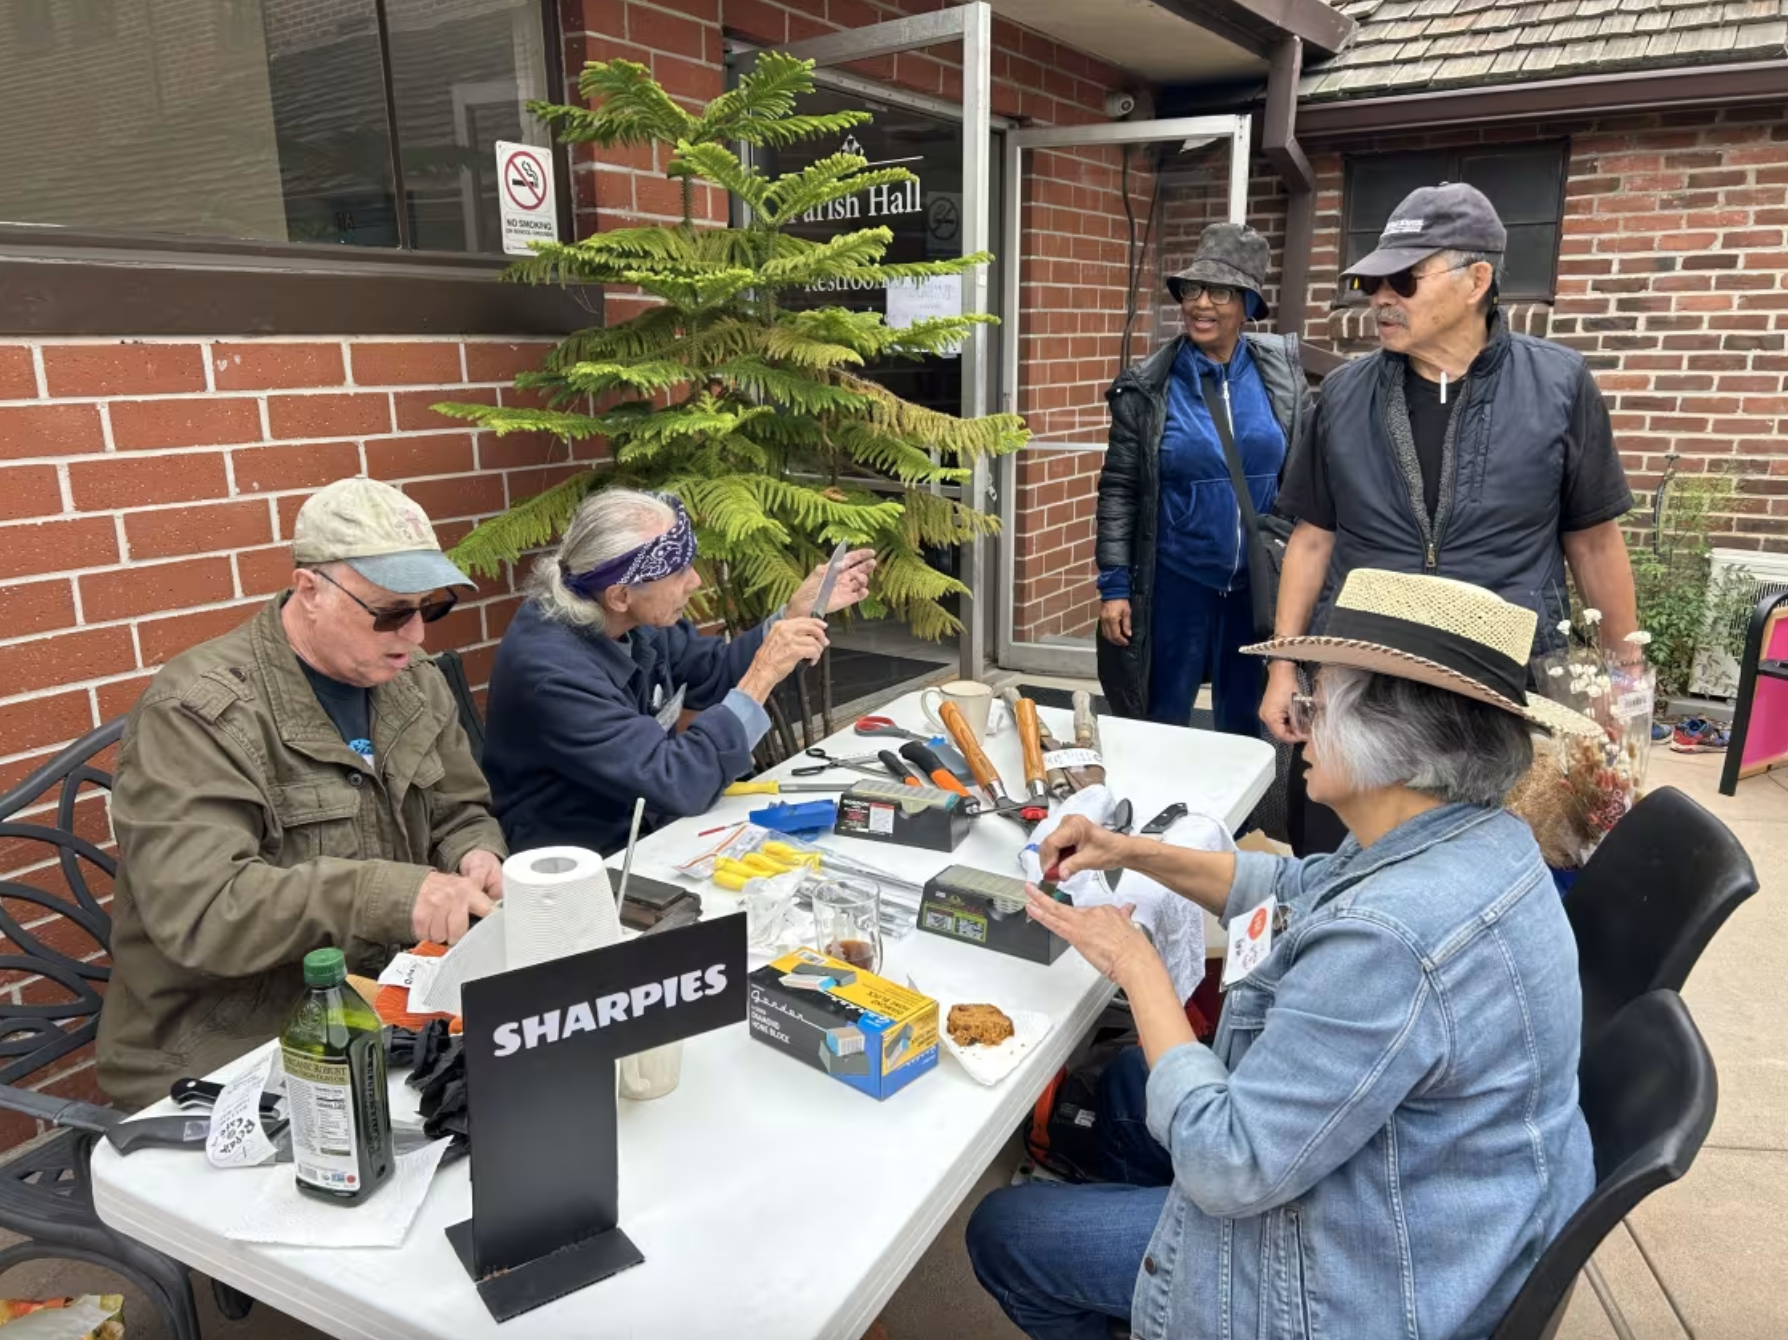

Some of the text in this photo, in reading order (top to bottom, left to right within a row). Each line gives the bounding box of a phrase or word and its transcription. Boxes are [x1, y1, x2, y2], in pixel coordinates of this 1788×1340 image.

[867, 178, 923, 217] Hall
[506, 218, 552, 230] NO SMOKING
[493, 963, 728, 1057] SHARPIES
